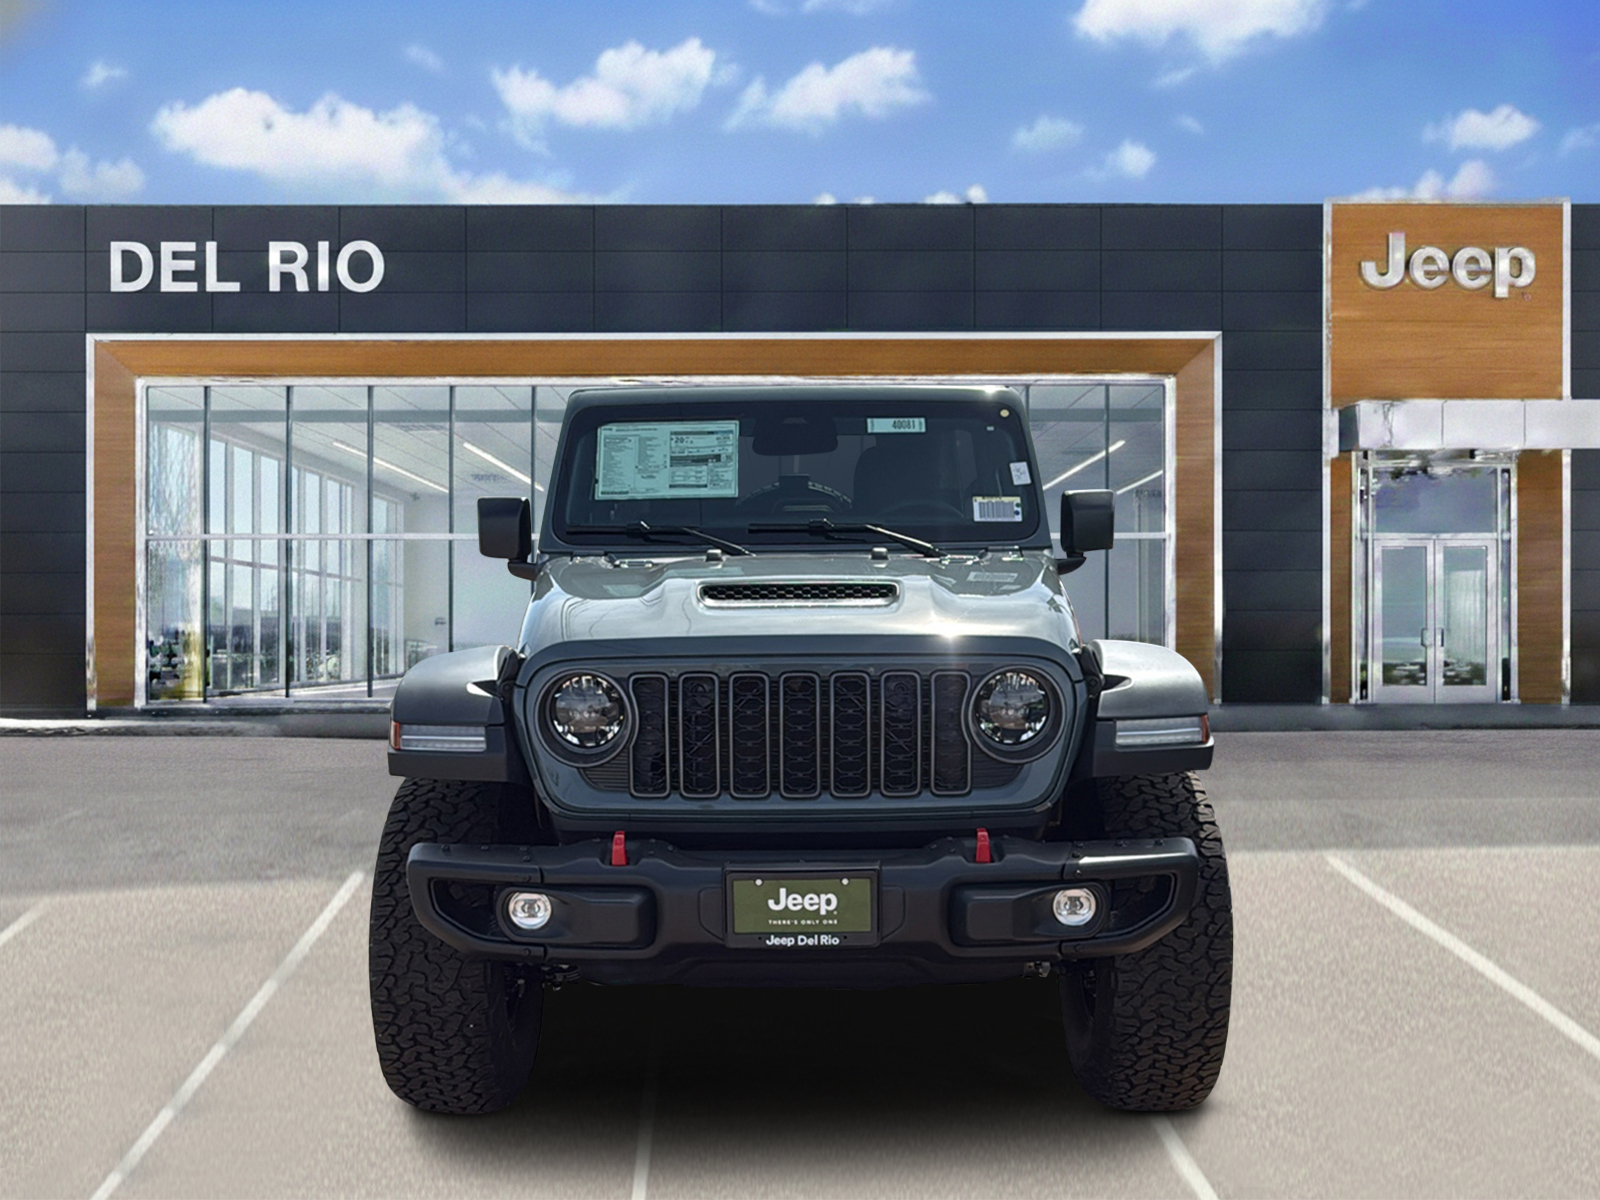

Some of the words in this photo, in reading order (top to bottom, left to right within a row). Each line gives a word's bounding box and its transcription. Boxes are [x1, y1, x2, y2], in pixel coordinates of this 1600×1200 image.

[110, 241, 241, 293] DEL
[268, 240, 385, 293] RIO
[1360, 231, 1536, 298] Jeep
[891, 419, 916, 430] 40081
[767, 887, 838, 915] Jeep
[765, 934, 795, 947] Jeep
[797, 934, 818, 945] Del
[820, 934, 840, 945] Rio
